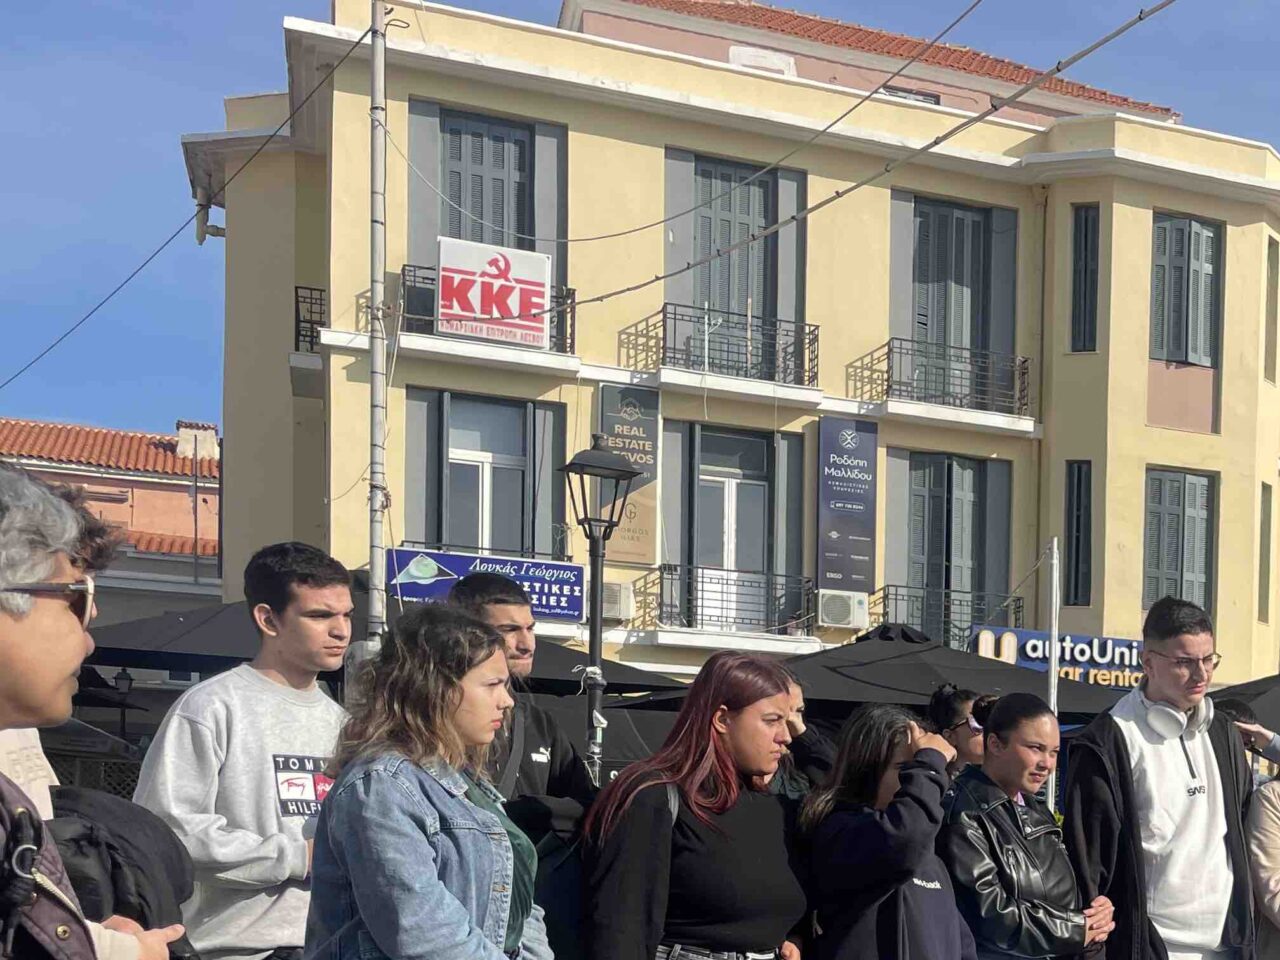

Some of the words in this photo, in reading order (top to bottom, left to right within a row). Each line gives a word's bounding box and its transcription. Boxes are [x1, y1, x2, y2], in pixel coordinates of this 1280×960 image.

[440, 274, 545, 325] ΚΚΕ
[614, 424, 647, 437] REAL
[608, 437, 653, 451] ESTATE
[469, 558, 517, 576] Λουκάς
[520, 563, 578, 582] Γεώργιος
[517, 581, 581, 596] ΣΤΙΚΕΣ
[531, 594, 568, 607] ΣΙΕΣ
[1025, 636, 1143, 667] autoUni
[1088, 668, 1143, 688] renta
